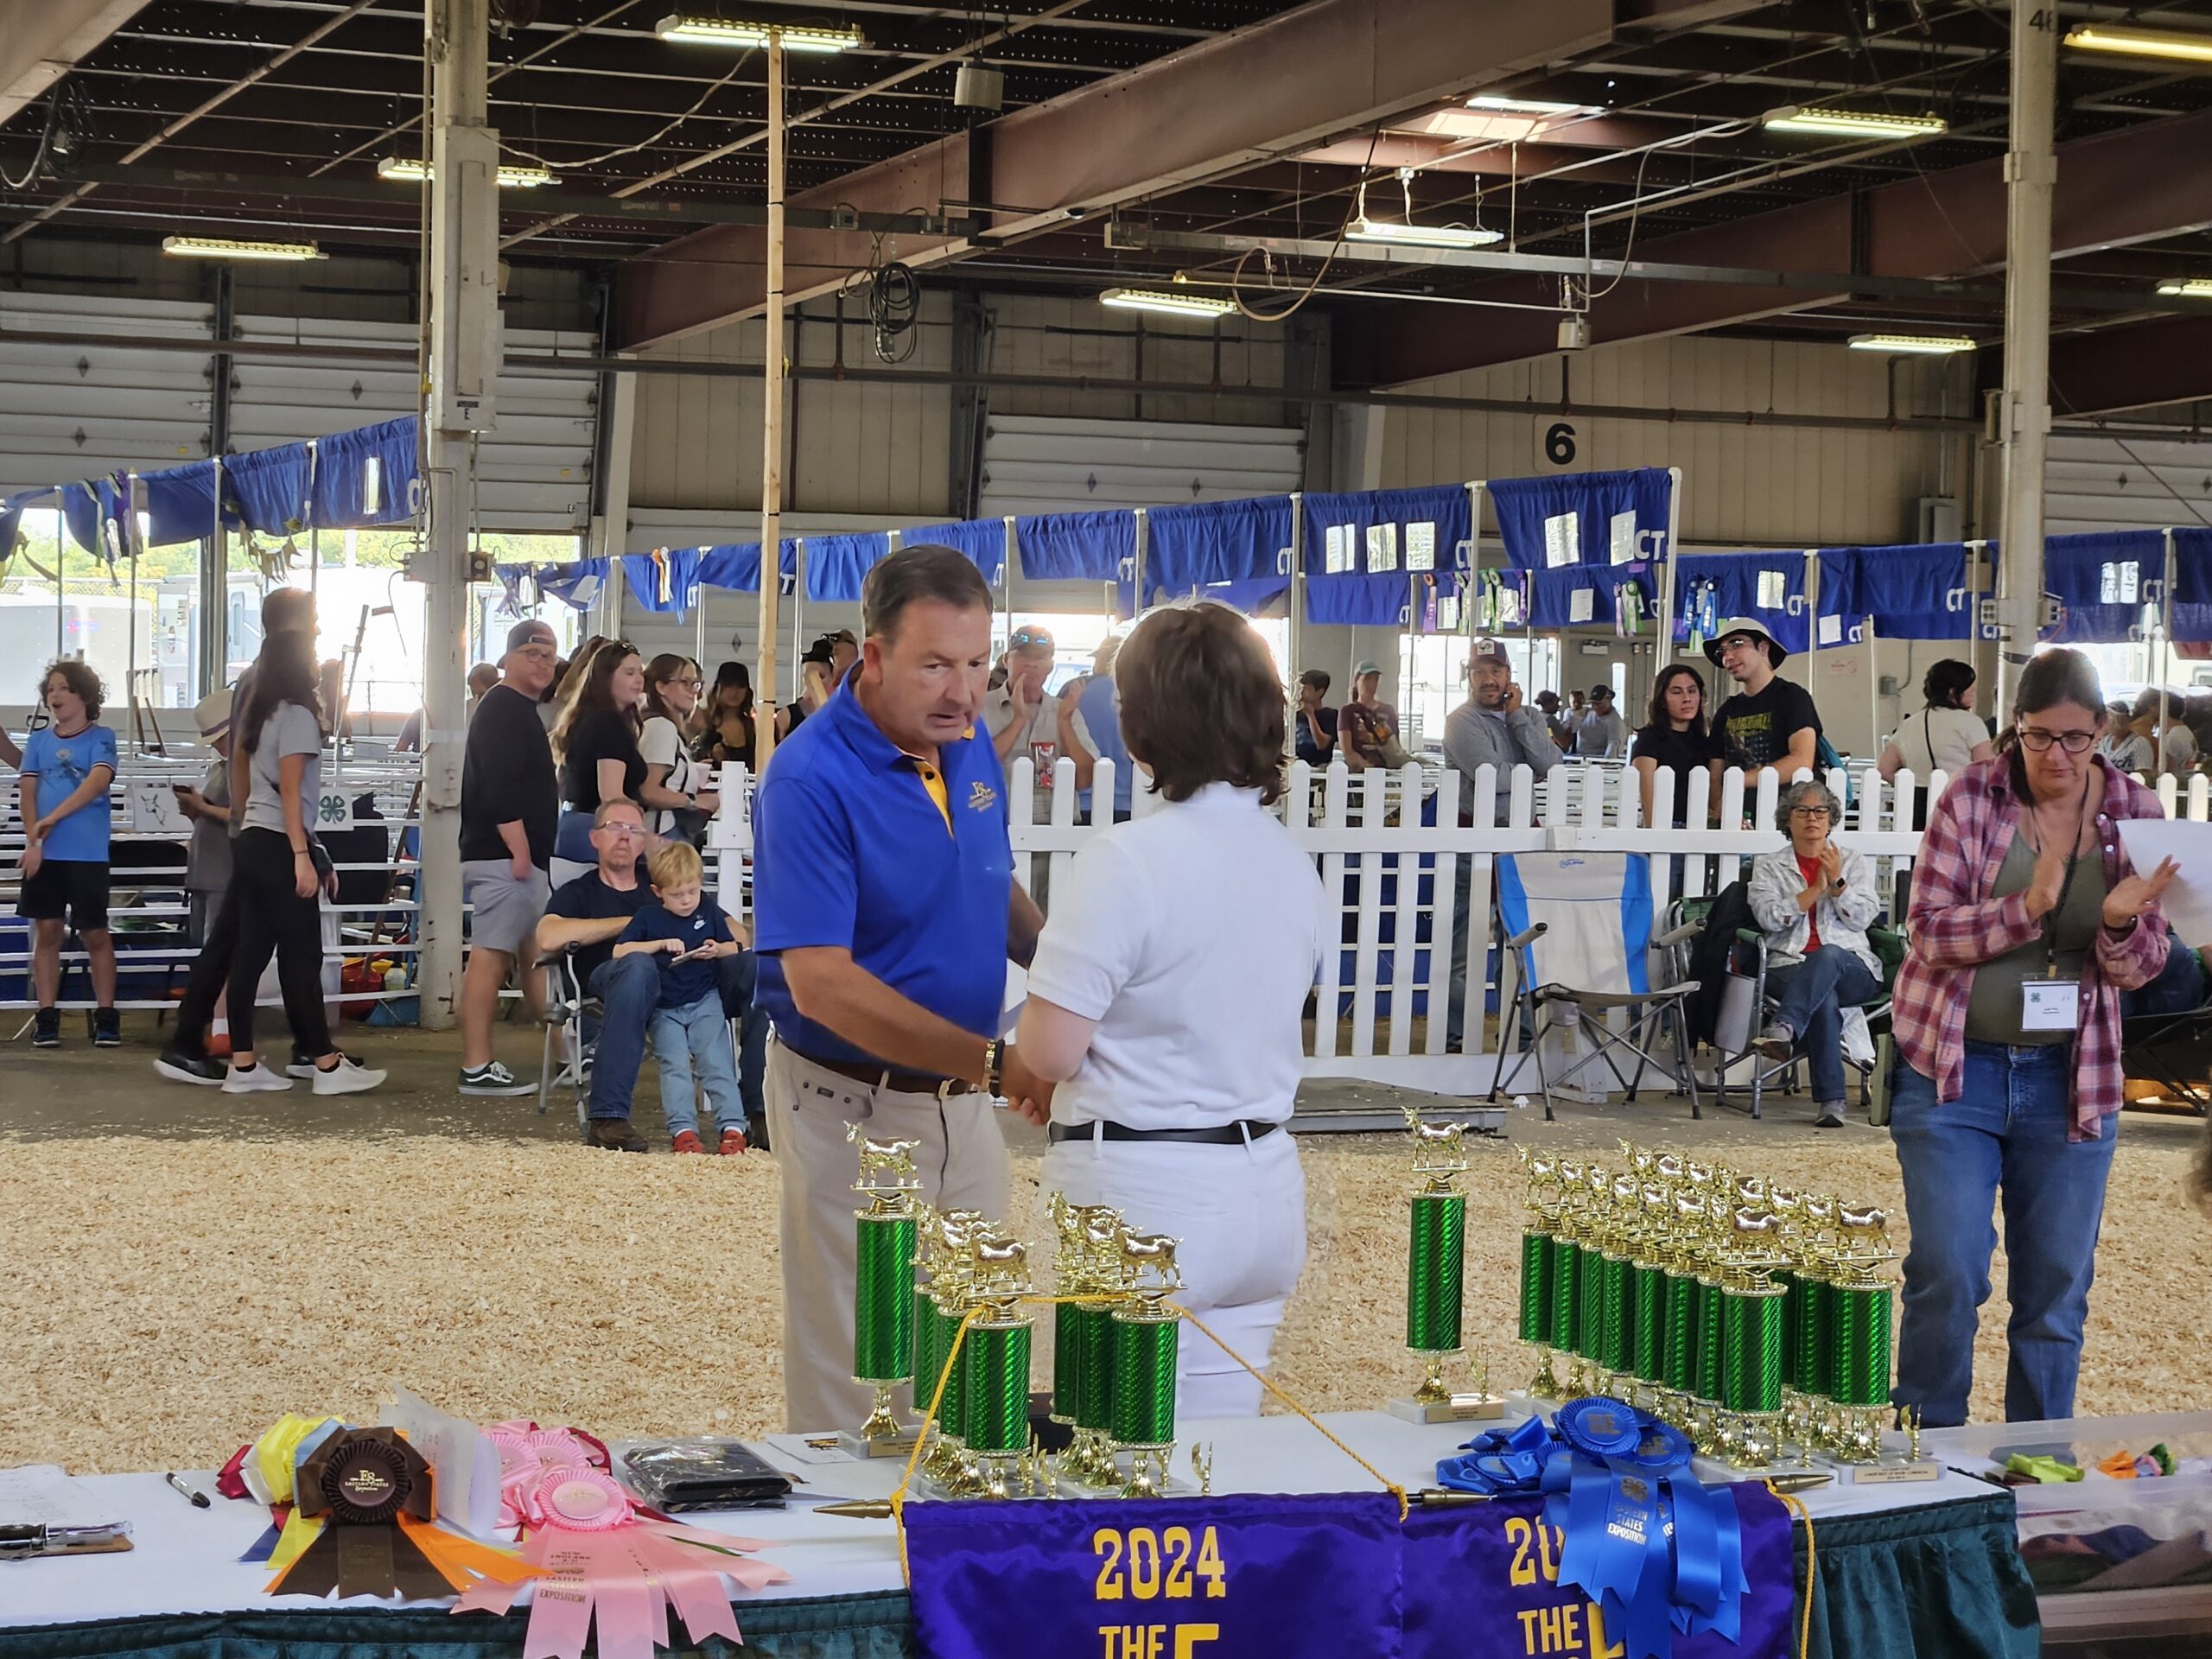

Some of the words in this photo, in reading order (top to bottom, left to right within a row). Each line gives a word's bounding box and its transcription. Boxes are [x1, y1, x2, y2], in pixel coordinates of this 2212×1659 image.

[1546, 423, 1576, 465] 6
[1634, 529, 1666, 561] CT
[779, 572, 796, 594] T
[2143, 578, 2163, 603] CT
[1787, 594, 1804, 616] CT
[1946, 588, 1965, 613] CT
[1399, 605, 1411, 624] CT
[1848, 625, 1863, 643] CT
[359, 1470, 375, 1484] ES
[1608, 1522, 1647, 1545] EXPOSITION
[1617, 1513, 1643, 1532] STATES
[1093, 1526, 1226, 1600] 2024
[540, 1589, 587, 1604] EXPOSITION
[1099, 1624, 1166, 1659] THE
[1517, 1604, 1583, 1656] THE
